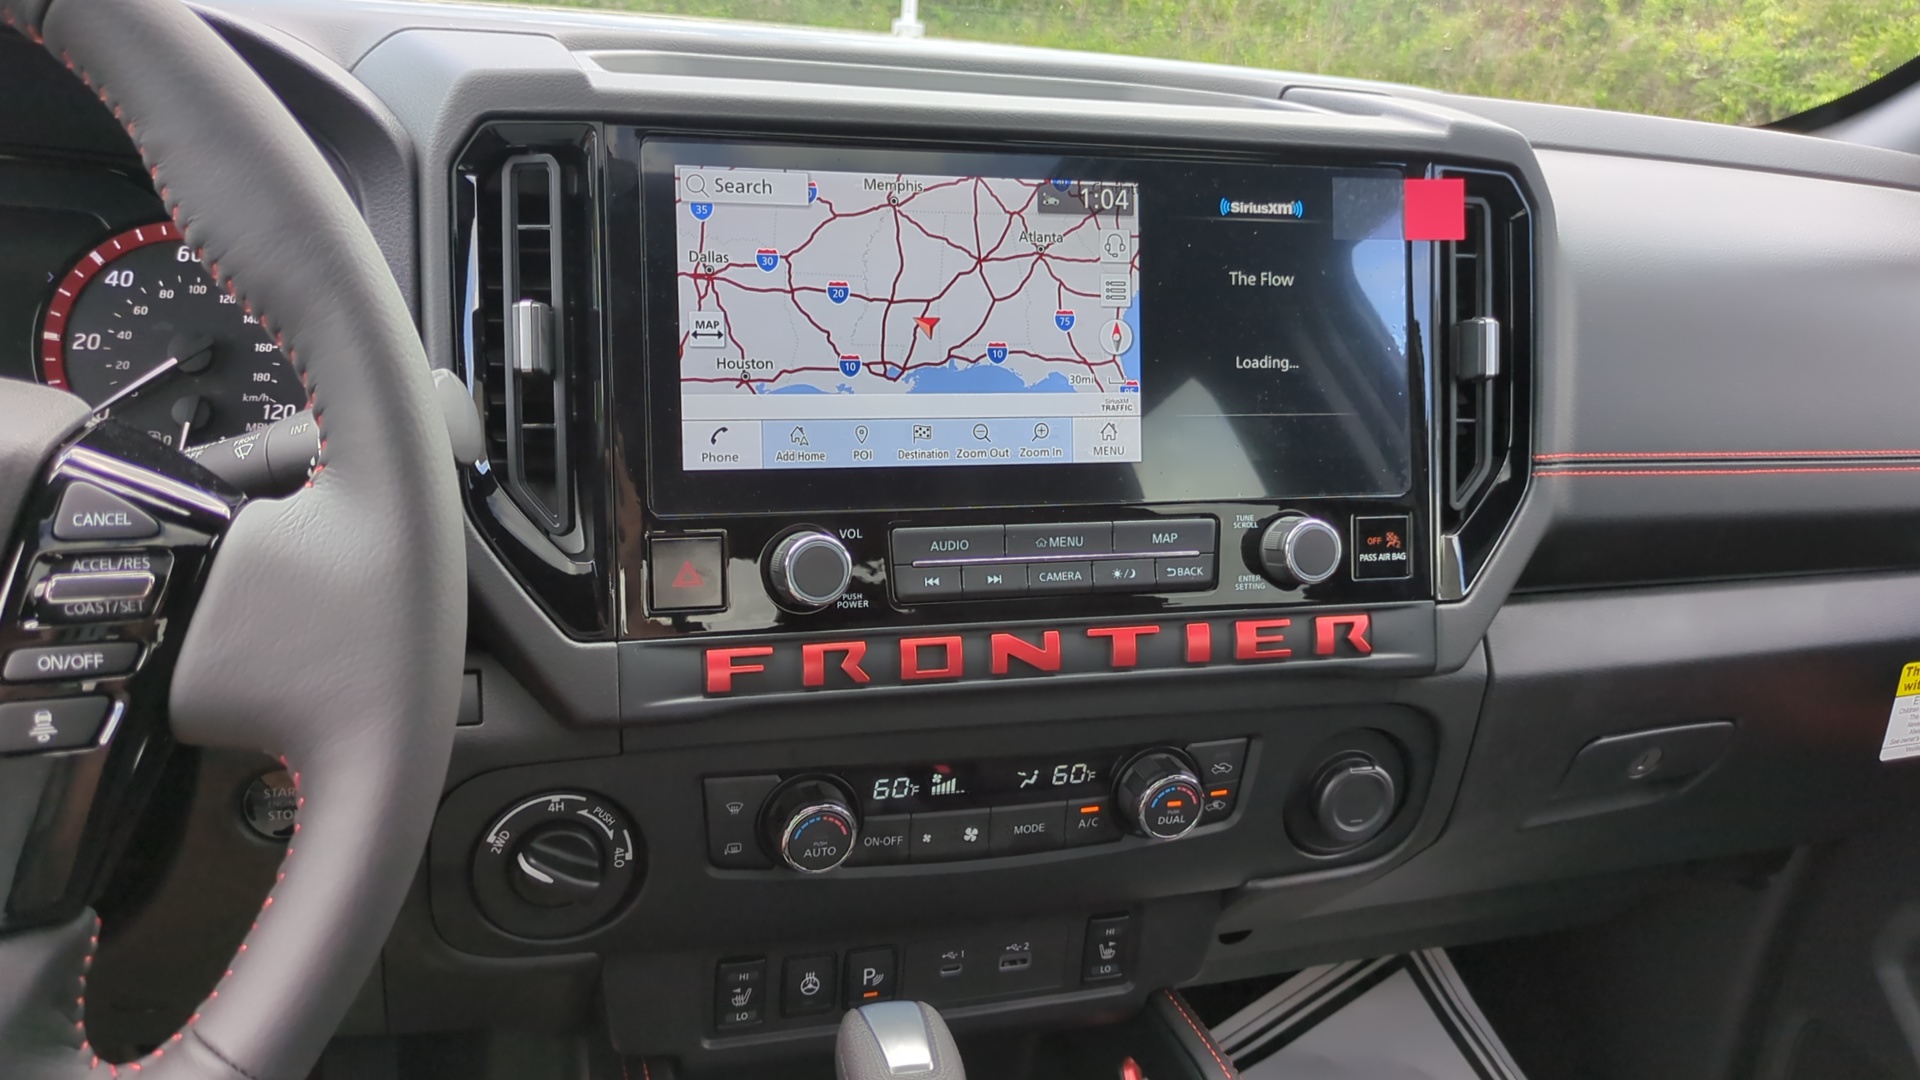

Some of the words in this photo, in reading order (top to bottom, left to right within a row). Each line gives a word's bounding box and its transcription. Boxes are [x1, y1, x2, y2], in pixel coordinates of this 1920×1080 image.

[714, 178, 773, 194] Search
[863, 178, 923, 192] Memphis
[1081, 187, 1129, 210] 1:04
[695, 205, 708, 214] 35
[1018, 230, 1063, 243] Atlanta
[689, 251, 729, 263] Dallas
[761, 257, 773, 266] 30
[104, 270, 134, 287] 40
[1229, 271, 1256, 286] The
[1260, 272, 1294, 287] Flow
[159, 289, 175, 299] 80
[188, 285, 207, 295] 100
[832, 289, 845, 298] 20
[219, 294, 236, 304] 120
[133, 305, 149, 316] 60
[695, 320, 720, 330] MAP
[1060, 317, 1070, 326] 75
[116, 331, 132, 340] 40
[72, 333, 101, 351] 20
[254, 343, 272, 353] 160
[992, 349, 1003, 358] 10
[115, 360, 130, 370] 20
[716, 357, 774, 370] Houston
[845, 362, 856, 371] 10
[1235, 356, 1299, 371] Loading...
[252, 372, 270, 382] 180
[1069, 375, 1094, 385] 30mi
[242, 393, 269, 402] km/h
[263, 404, 296, 420] 120
[290, 423, 309, 435] INT
[233, 433, 261, 446] FRONT
[775, 451, 796, 462] Add
[798, 451, 826, 461] Home
[853, 450, 873, 460] POI
[898, 449, 949, 460] Destination
[956, 449, 987, 459] Zoom
[990, 448, 1010, 458] Out
[1019, 448, 1046, 458] Zoom
[1048, 448, 1062, 457] In
[1093, 446, 1125, 456] MENU
[701, 452, 739, 463] Phone
[72, 512, 132, 527] CANCEL
[1233, 521, 1259, 529] SCROLL
[839, 528, 863, 539] VOL
[1152, 533, 1178, 544] MAP
[930, 540, 969, 551] AUDIO
[1049, 536, 1084, 547] MENU
[1366, 537, 1382, 546] OFF
[1359, 553, 1377, 562] PASS
[1378, 552, 1391, 561] AIR
[1391, 551, 1407, 561] BAG
[72, 557, 150, 572] ACCEL/RES
[1038, 571, 1082, 582] CAMERA
[1177, 566, 1204, 577] BACK
[1238, 575, 1261, 583] ENTER
[1234, 582, 1266, 591] SETTING
[842, 592, 863, 600] PUSH
[64, 601, 145, 616] COAST/SET
[836, 600, 869, 609] POWER
[705, 614, 1372, 693] FRONTIER
[37, 653, 104, 671] ON/OFF
[263, 786, 297, 799] STAR
[547, 802, 565, 812] 4H
[267, 809, 297, 821] STO
[592, 806, 616, 826] PUSH
[1157, 815, 1186, 826] DUAL
[1078, 816, 1099, 829] A/C
[1013, 822, 1045, 836] MODE
[490, 830, 511, 855] 2WD
[613, 847, 625, 868] 4LO
[803, 846, 837, 859] AUTO
[1105, 928, 1115, 936] HI
[1100, 964, 1111, 974] LO
[739, 972, 749, 981] HI
[736, 1012, 749, 1021] LO
